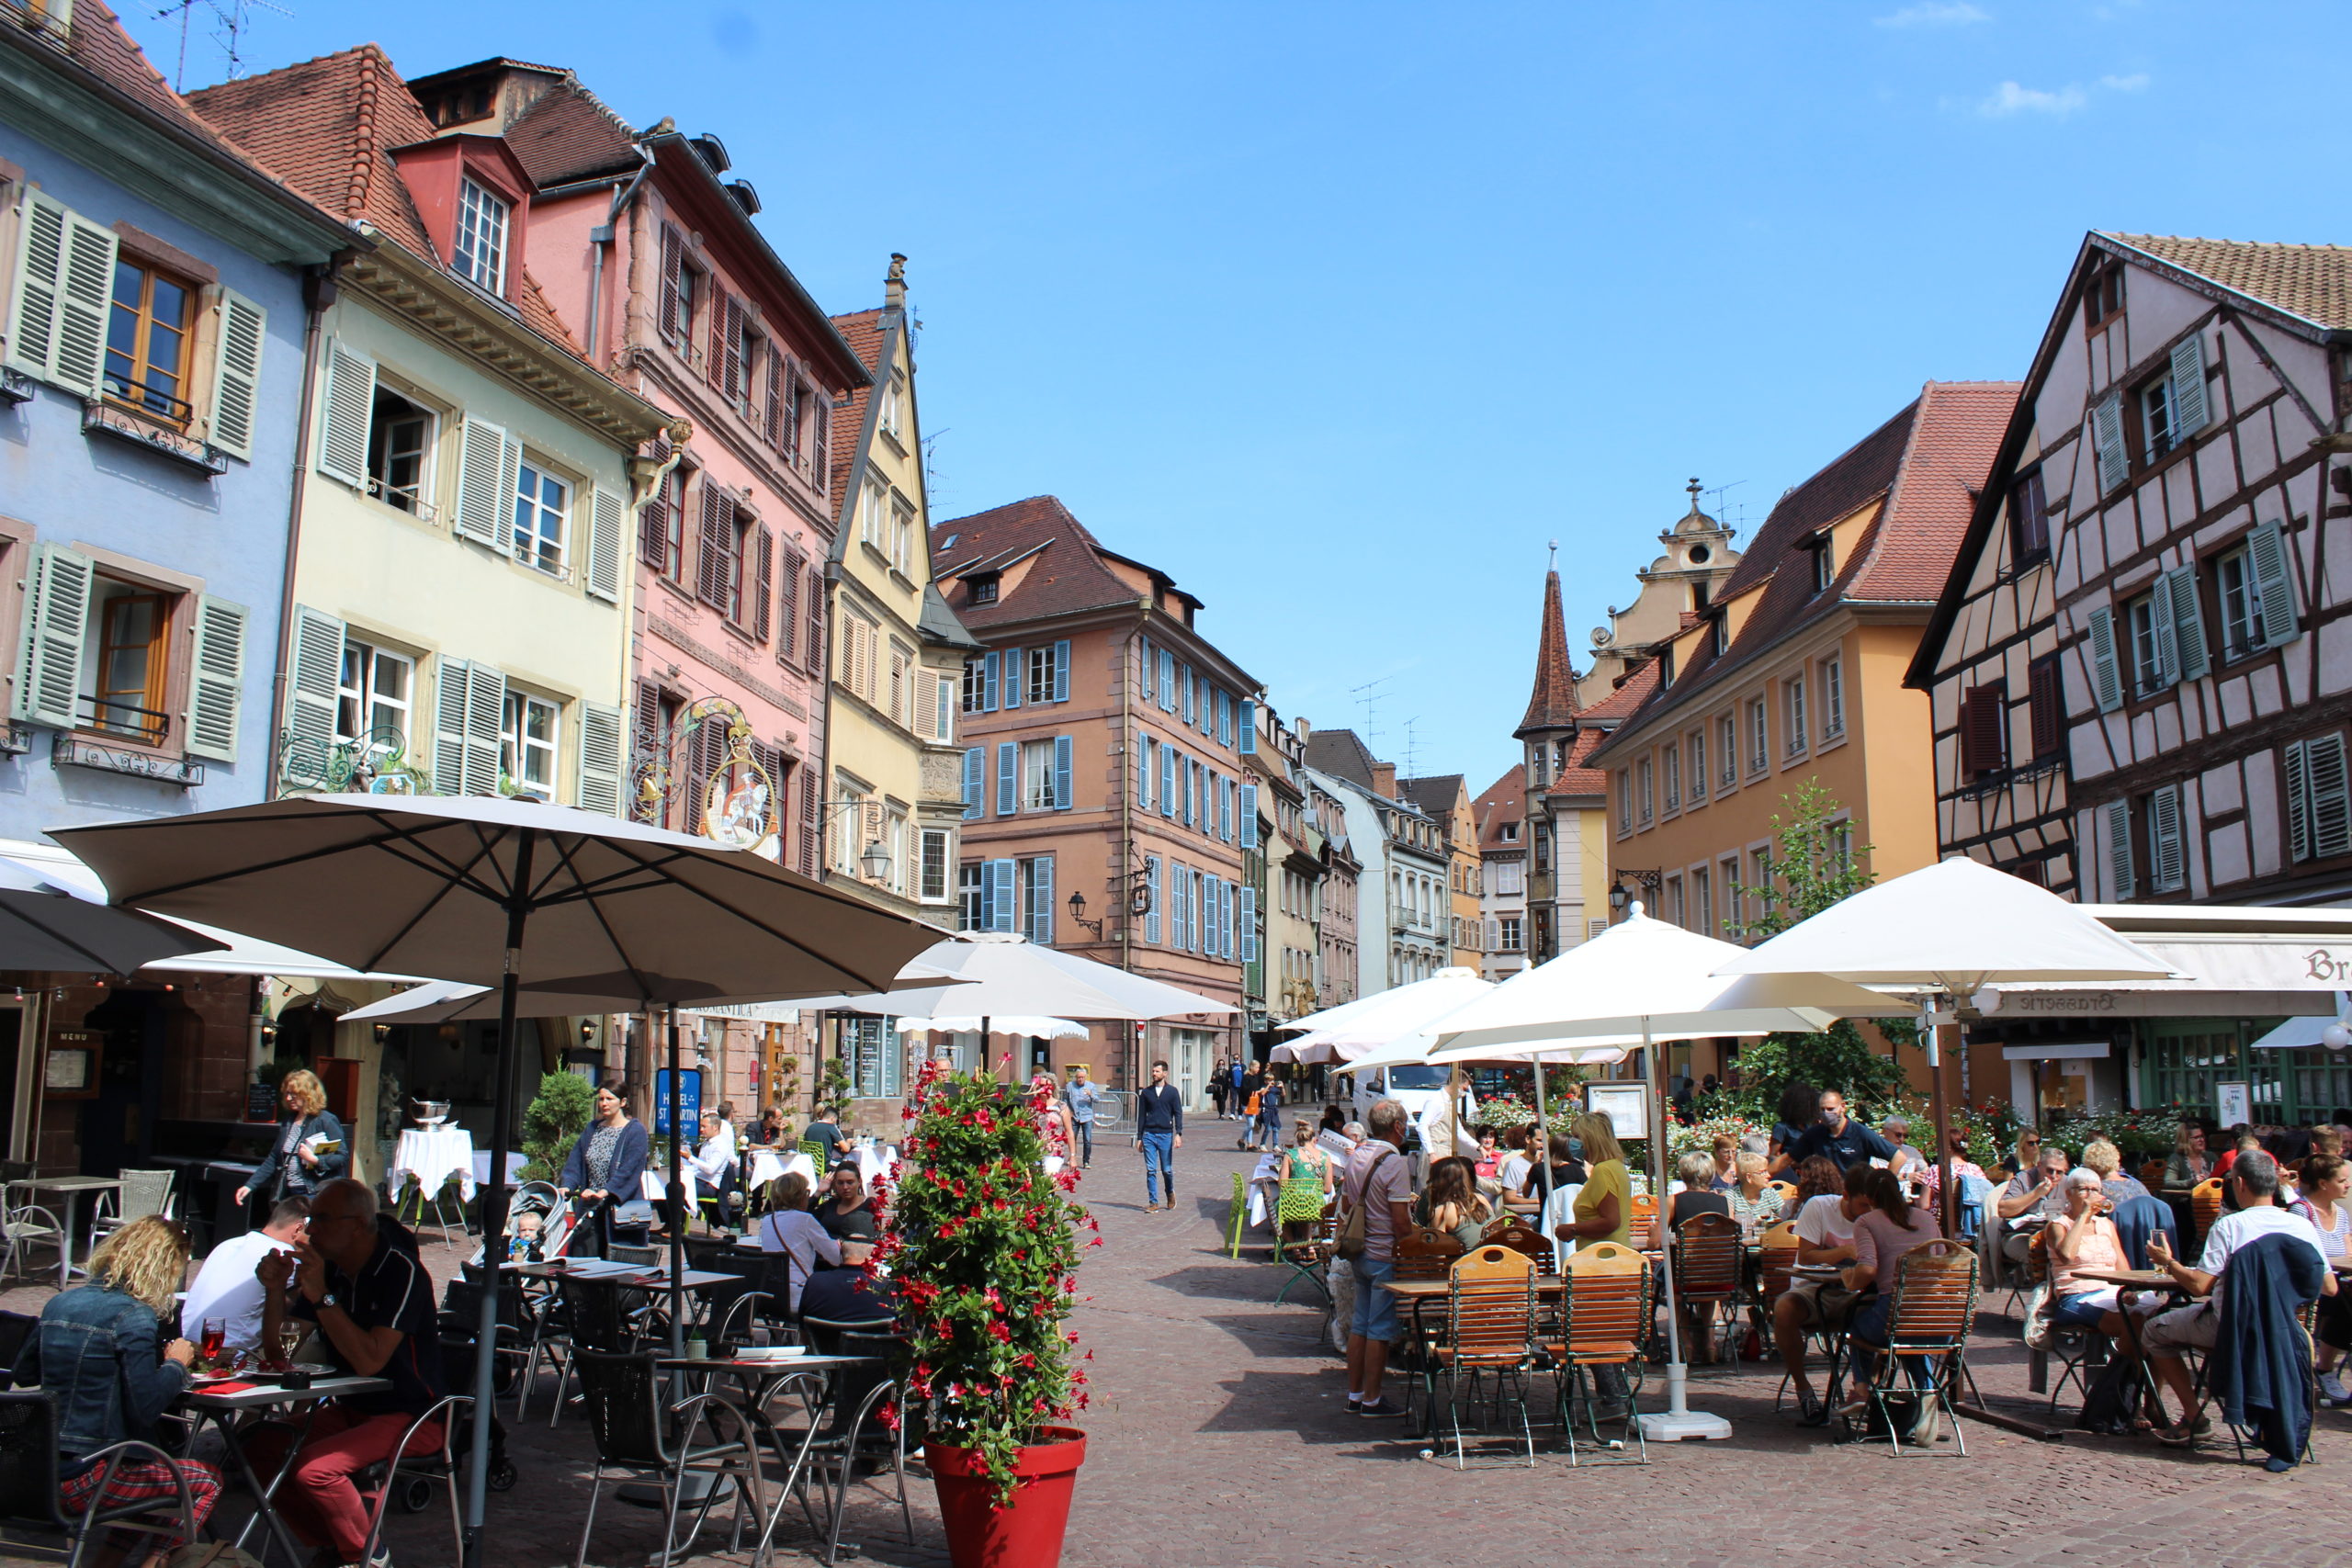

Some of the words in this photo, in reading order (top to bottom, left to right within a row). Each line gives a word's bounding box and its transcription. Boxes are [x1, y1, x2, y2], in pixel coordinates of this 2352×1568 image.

[2301, 949, 2352, 981] Br
[60, 1032, 87, 1041] MENU
[663, 1092, 688, 1105] HEL
[659, 1107, 667, 1120] ST
